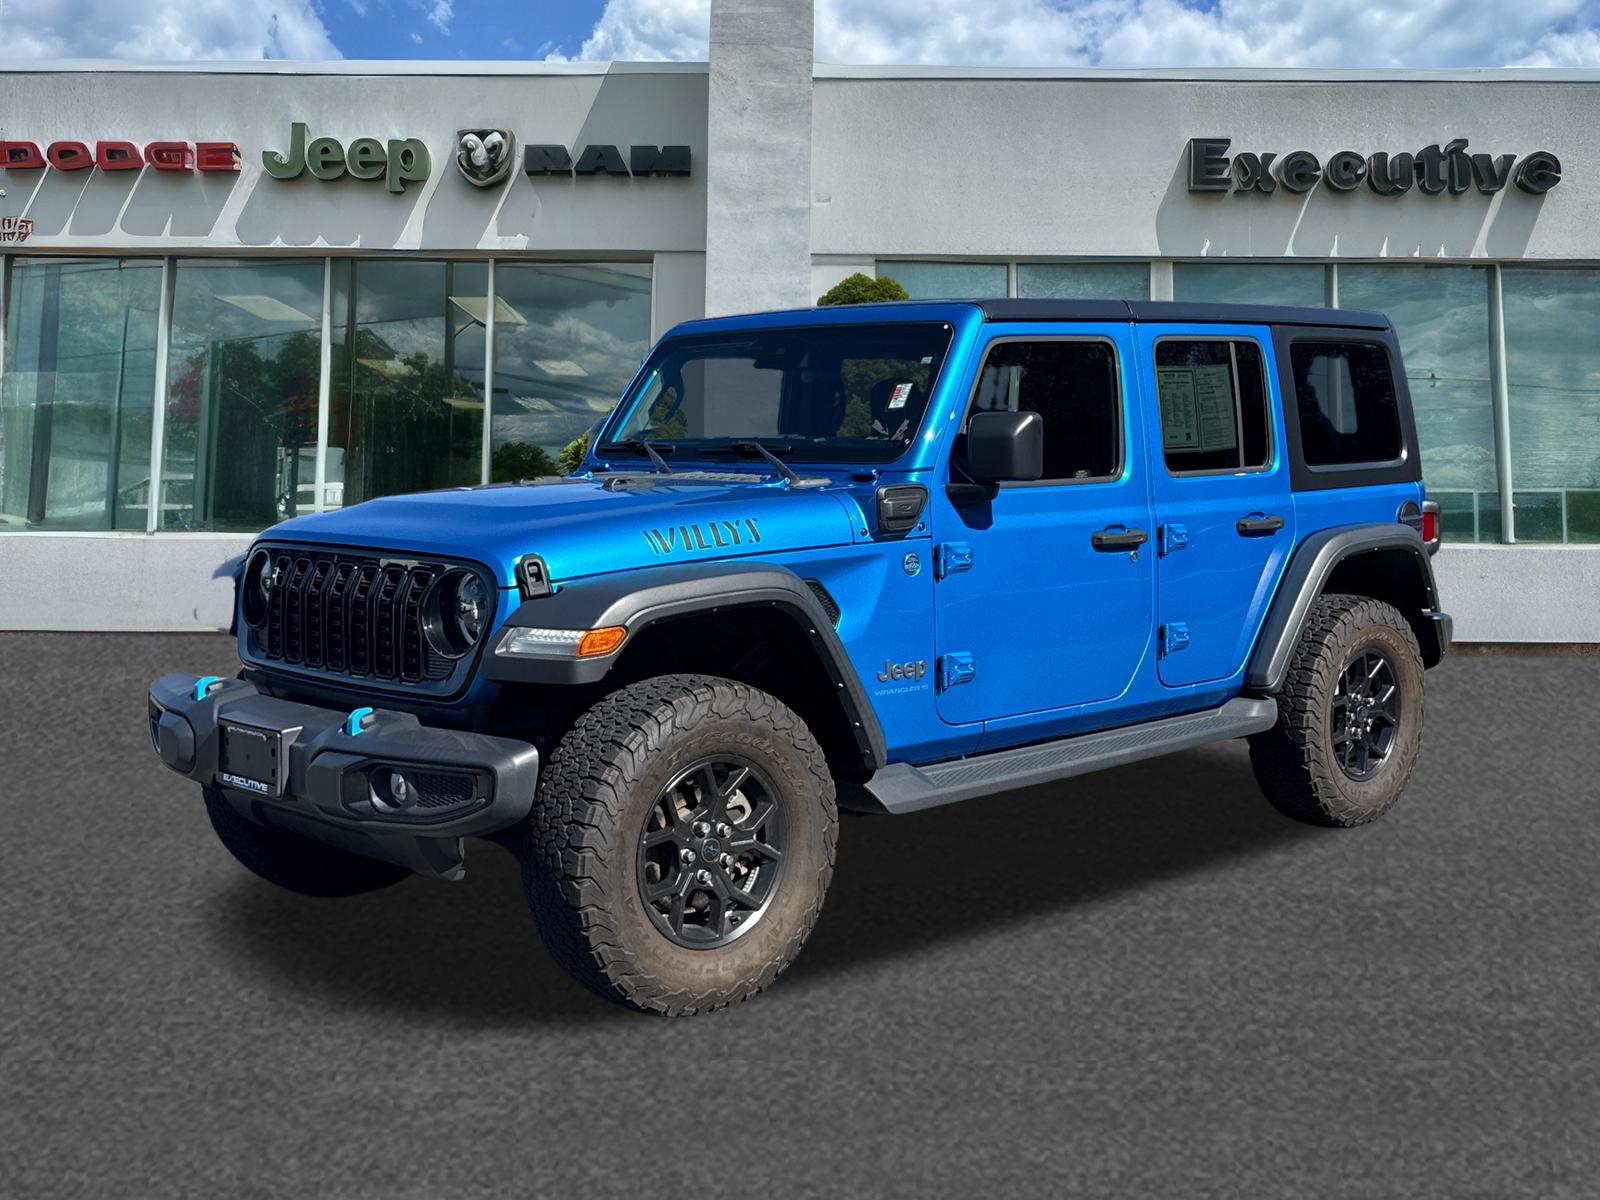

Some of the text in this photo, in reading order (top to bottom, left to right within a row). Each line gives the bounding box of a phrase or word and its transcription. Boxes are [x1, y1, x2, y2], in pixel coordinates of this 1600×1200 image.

[0, 141, 242, 174] DODGE
[262, 122, 431, 192] Jeep
[1187, 137, 1562, 195] Executive
[642, 517, 761, 556] WILLYS
[877, 659, 927, 682] Jeep
[874, 685, 921, 697] WRANGLER
[223, 773, 268, 791] EXECUTIVE
